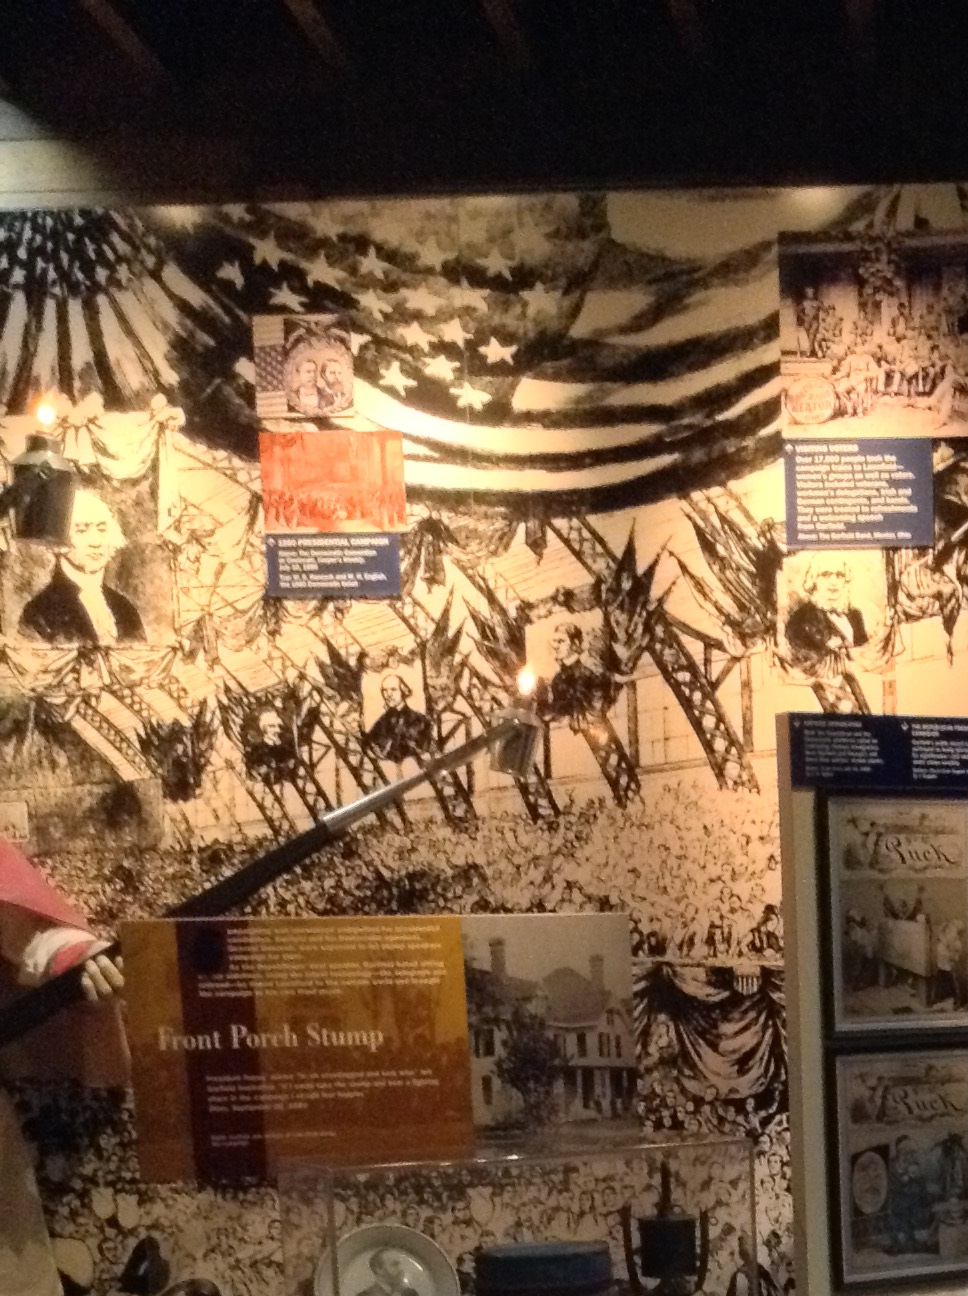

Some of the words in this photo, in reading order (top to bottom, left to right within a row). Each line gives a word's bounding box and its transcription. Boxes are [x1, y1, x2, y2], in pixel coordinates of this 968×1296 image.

[885, 836, 960, 865] Puck
[158, 1026, 222, 1050] Front
[231, 1022, 299, 1049] Porch
[307, 1021, 385, 1053] Stump
